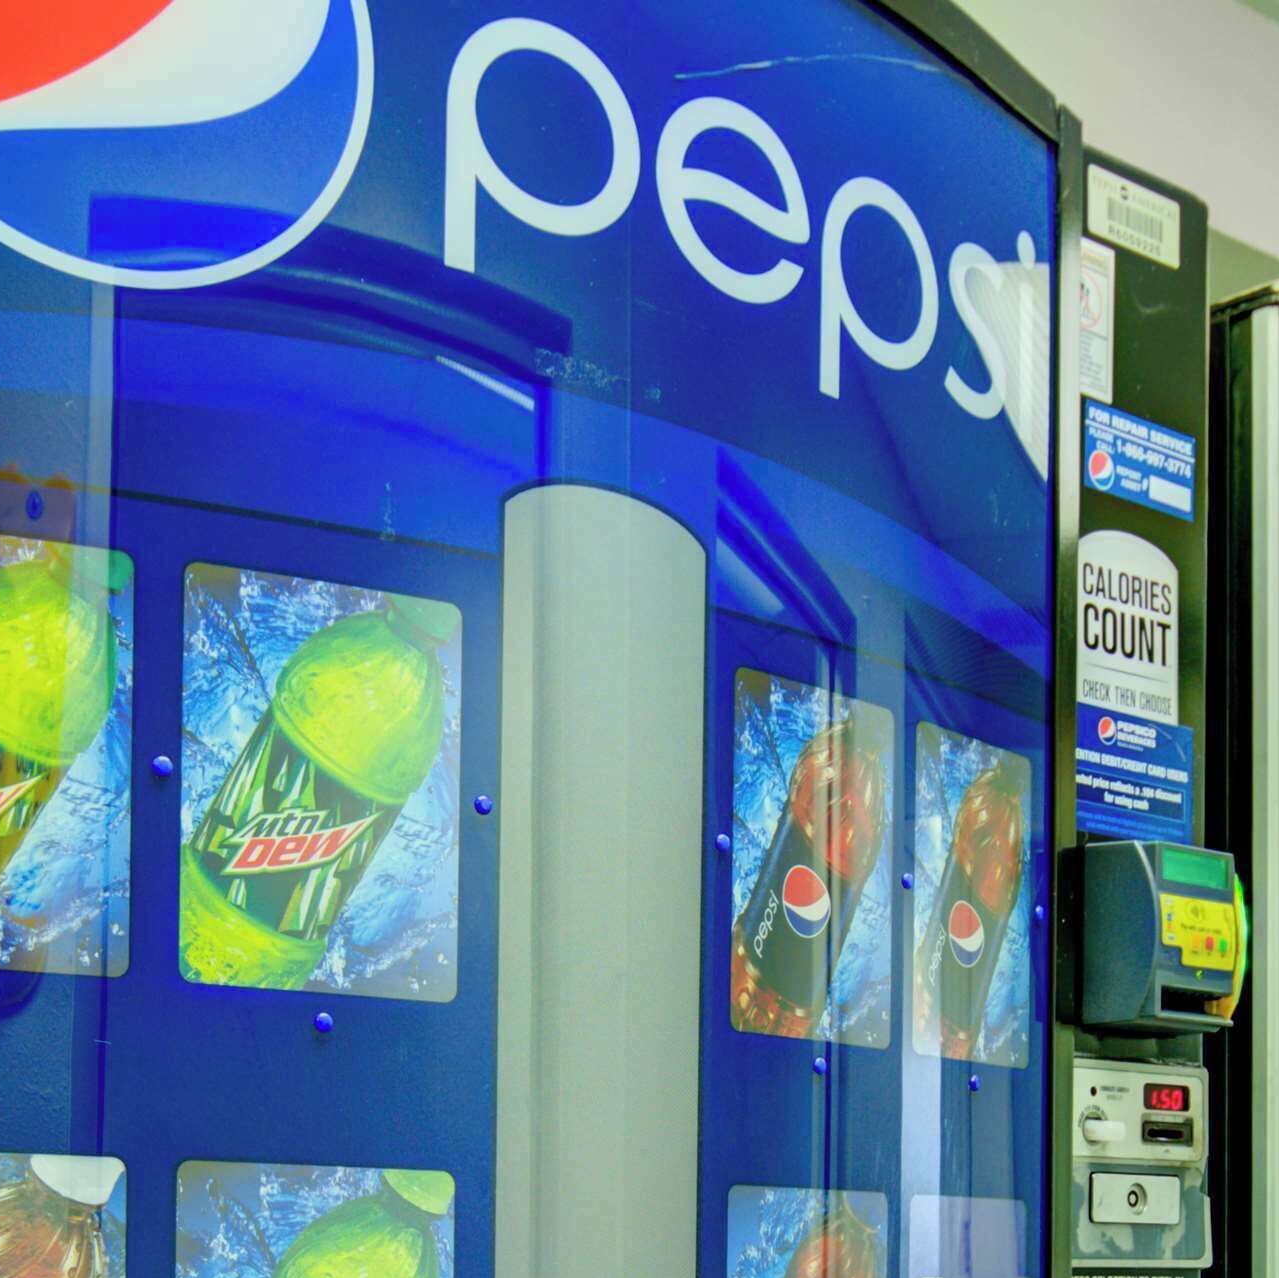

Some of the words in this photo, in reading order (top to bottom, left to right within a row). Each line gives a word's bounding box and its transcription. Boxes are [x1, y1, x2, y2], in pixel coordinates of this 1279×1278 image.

[1089, 406, 1110, 425] FOR
[1111, 414, 1148, 440] REPAIR
[1150, 429, 1193, 456] SERVICE
[1082, 562, 1173, 615] CALORIES
[1083, 602, 1172, 667] COUNT
[1082, 678, 1111, 703] CHECK
[1115, 686, 1136, 708] THEN
[1139, 691, 1172, 716] CHOOSE
[753, 890, 779, 959] pepsi
[928, 928, 947, 986] pepsi
